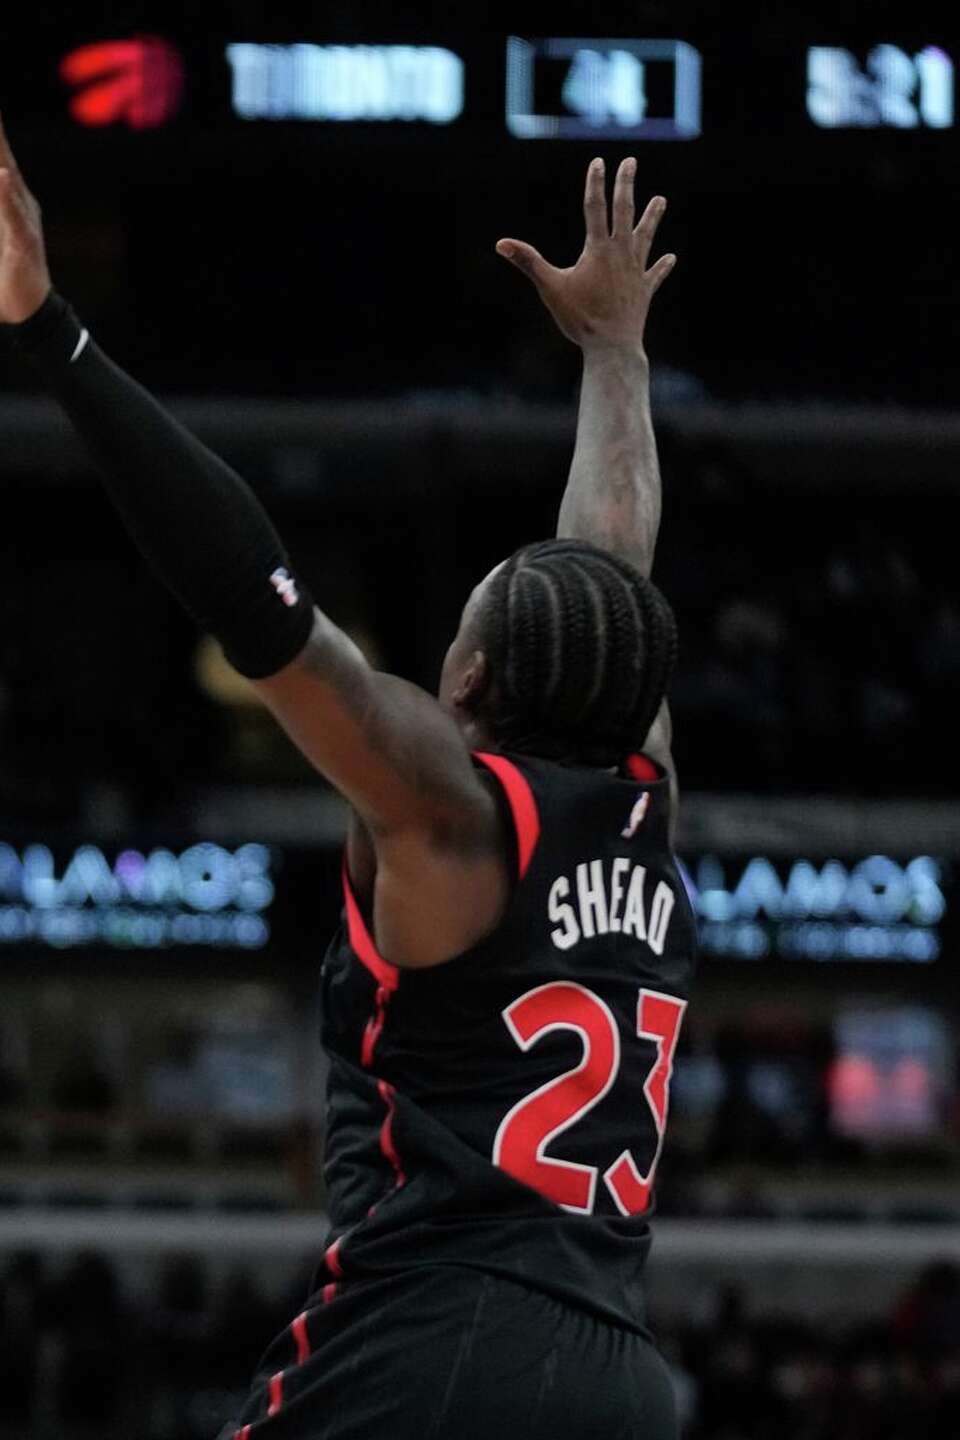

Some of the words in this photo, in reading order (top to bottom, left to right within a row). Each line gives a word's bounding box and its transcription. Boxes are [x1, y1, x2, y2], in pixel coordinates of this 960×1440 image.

[548, 857, 675, 956] SHEAD
[676, 854, 946, 925] LAMOS
[492, 981, 688, 1216] 23
